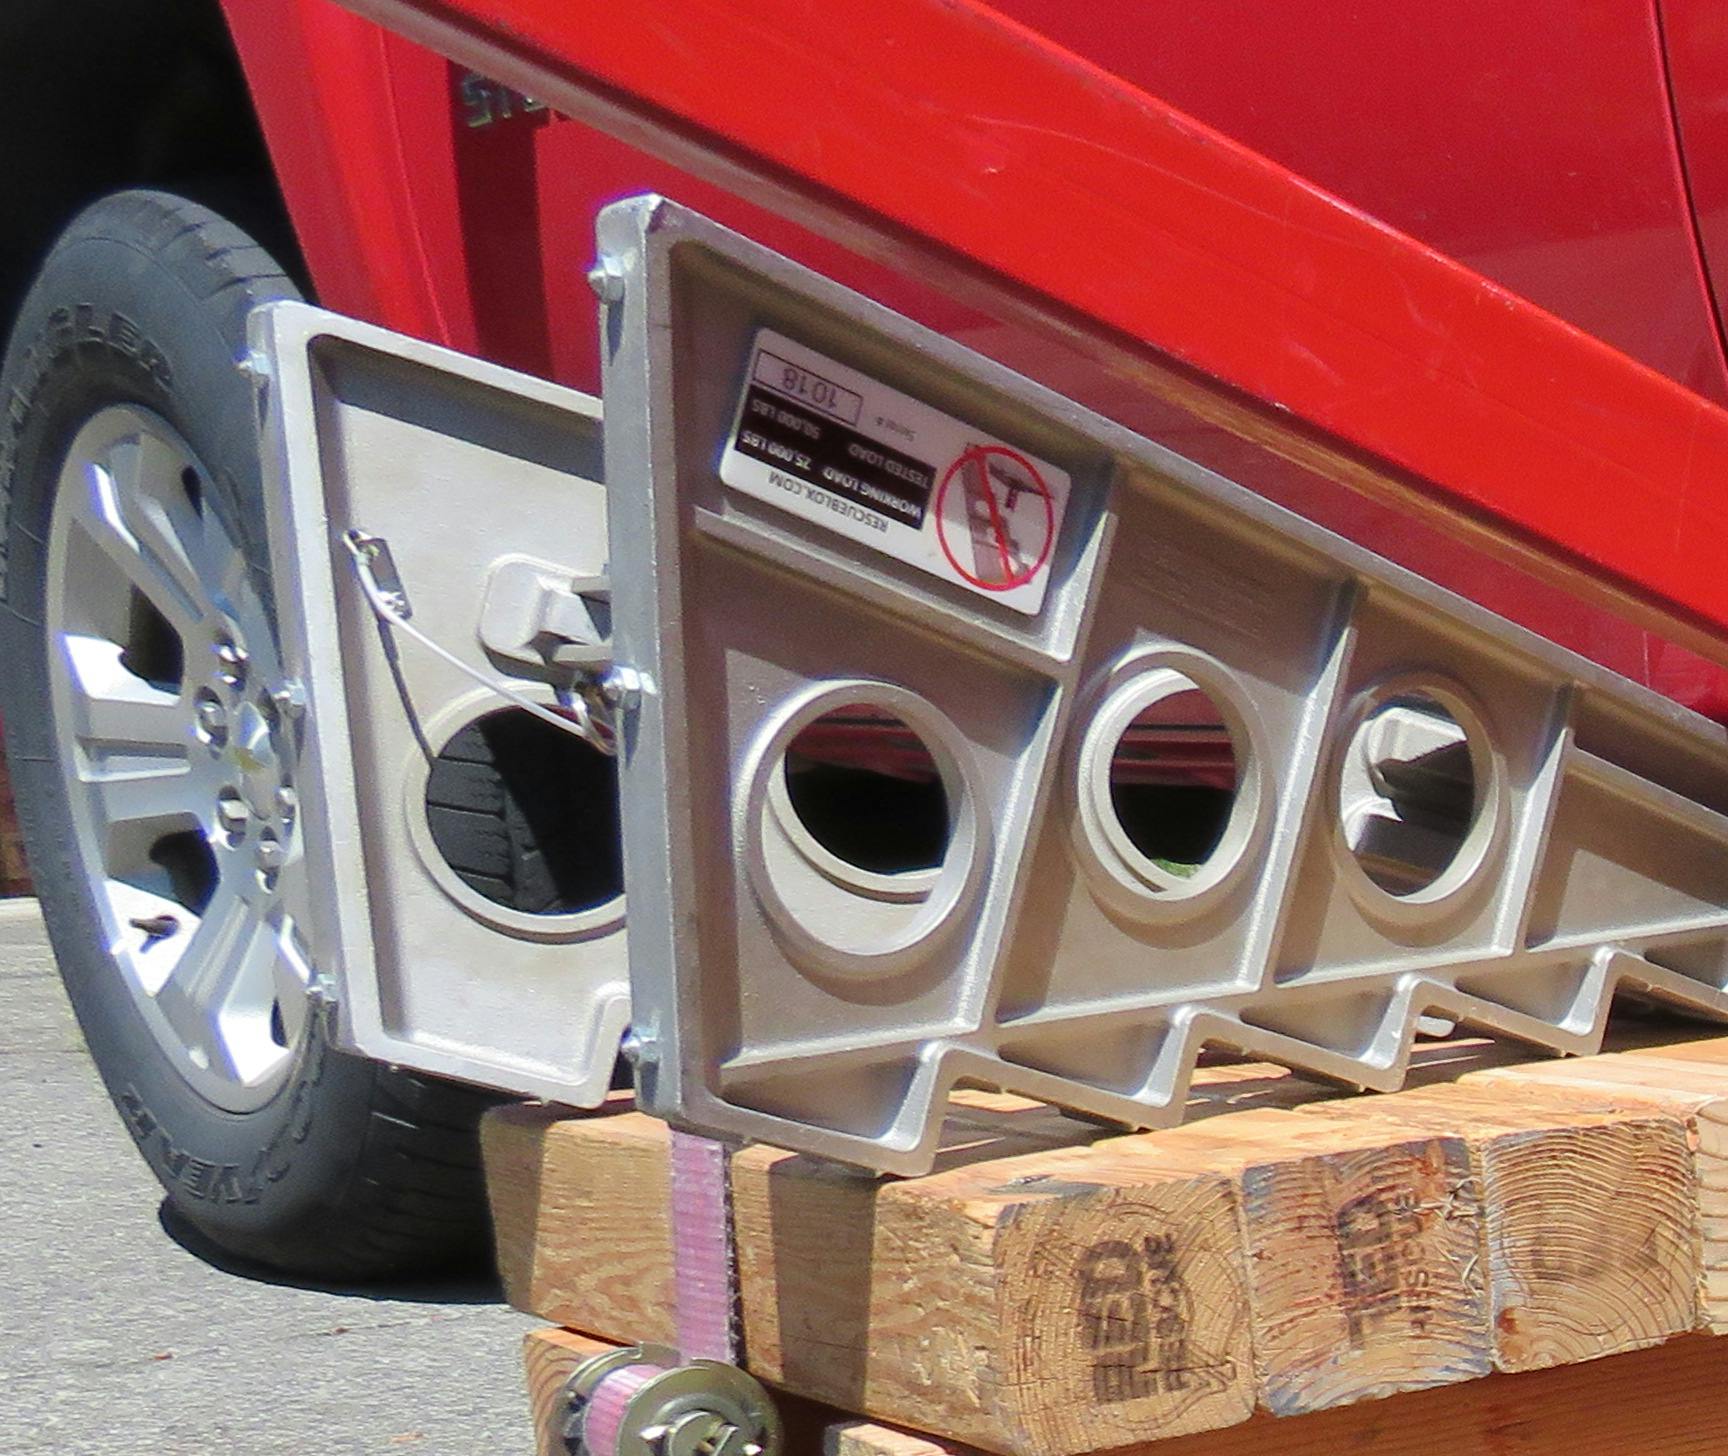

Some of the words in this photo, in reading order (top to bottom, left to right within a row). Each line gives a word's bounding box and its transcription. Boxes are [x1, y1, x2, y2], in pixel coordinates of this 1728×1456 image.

[751, 399, 775, 419] LBS
[741, 431, 767, 451] LBS
[848, 443, 885, 467] LOAD
[822, 465, 860, 494] LOAD
[885, 458, 929, 489] TESTED
[768, 471, 889, 532] RESCUEBLOX.COM
[861, 482, 922, 520] WORKING
[1078, 1240, 1159, 1402] RED
